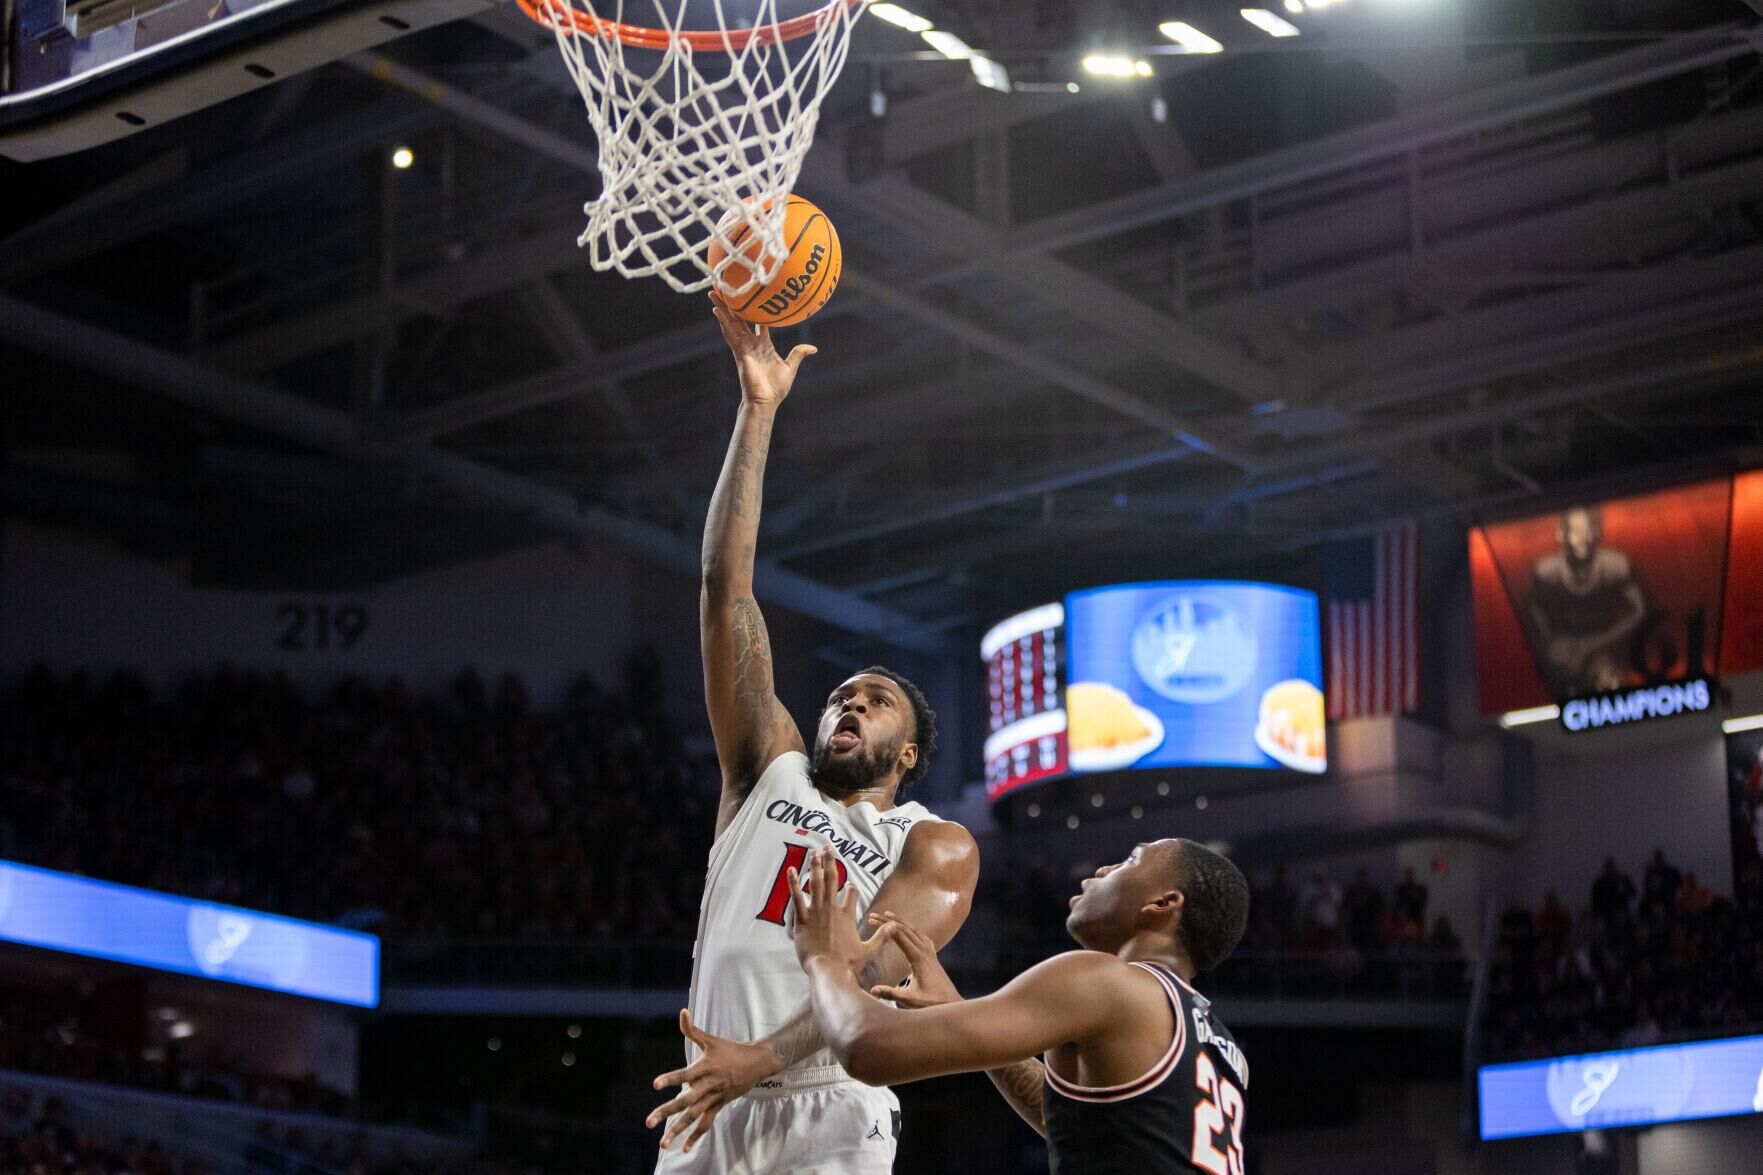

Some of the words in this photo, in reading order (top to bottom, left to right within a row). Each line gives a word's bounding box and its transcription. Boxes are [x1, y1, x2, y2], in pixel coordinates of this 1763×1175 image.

[758, 243, 826, 316] Wilson
[276, 602, 367, 650] 219
[1563, 679, 1710, 731] CHAMPIONS
[766, 799, 893, 877] CINCINNATI
[1191, 1051, 1245, 1175] 23
